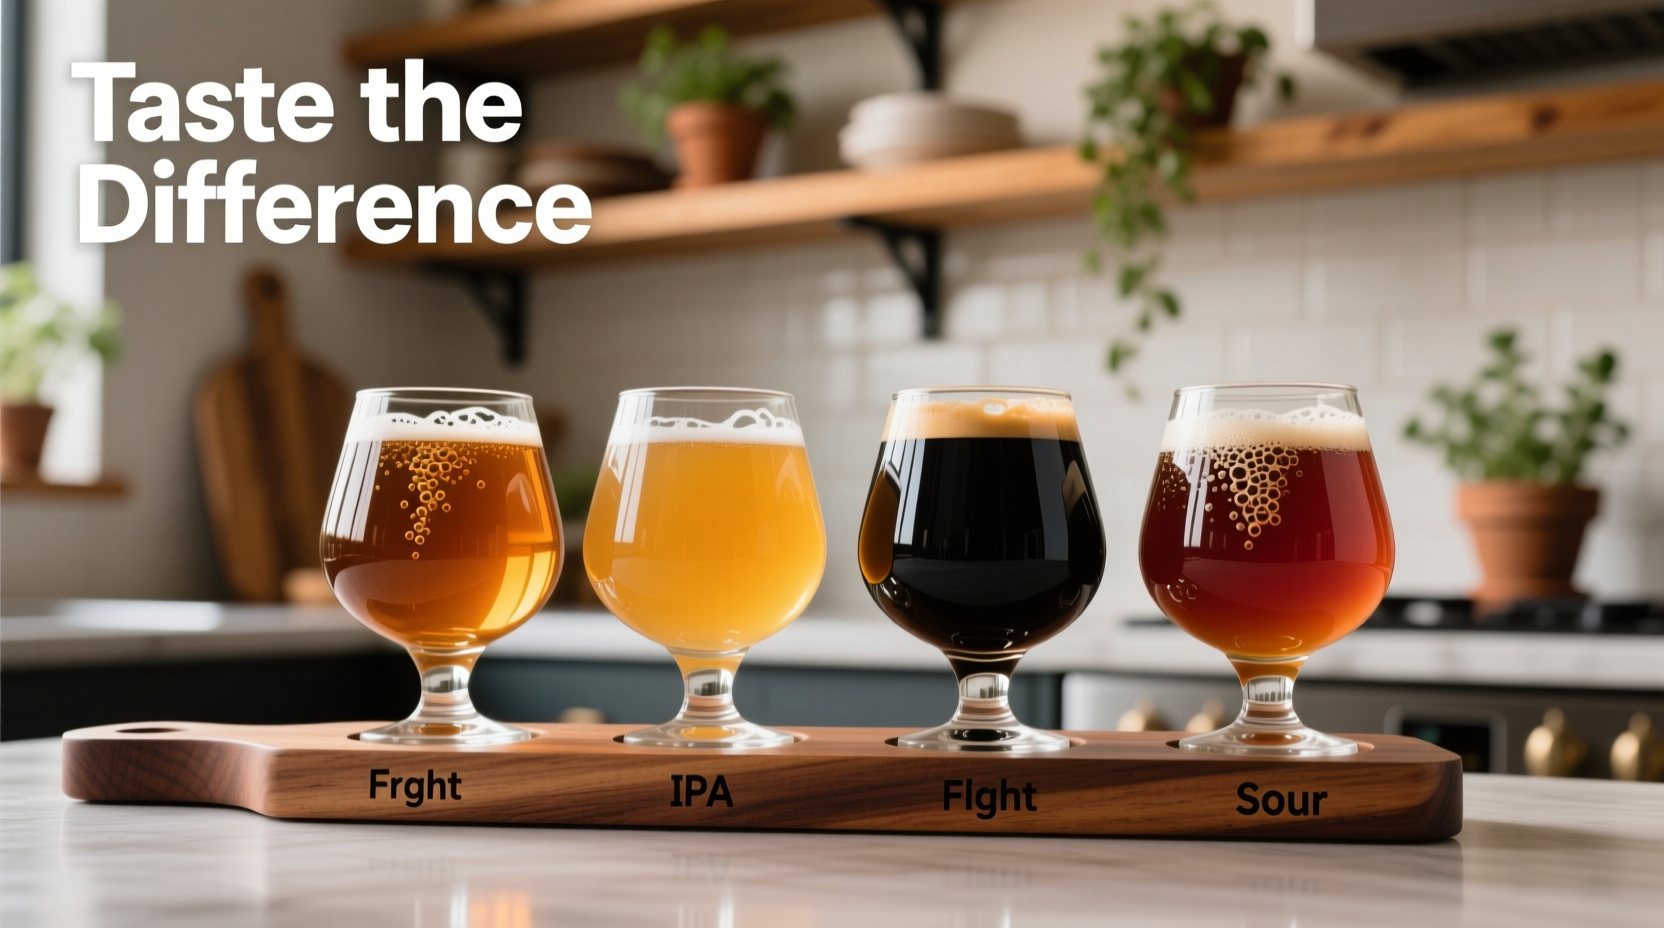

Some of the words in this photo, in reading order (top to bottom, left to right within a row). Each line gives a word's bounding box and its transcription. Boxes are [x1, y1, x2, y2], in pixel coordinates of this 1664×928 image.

[369, 768, 463, 808] Frght
[669, 774, 734, 808] IPA
[1235, 782, 1329, 816] Sour
